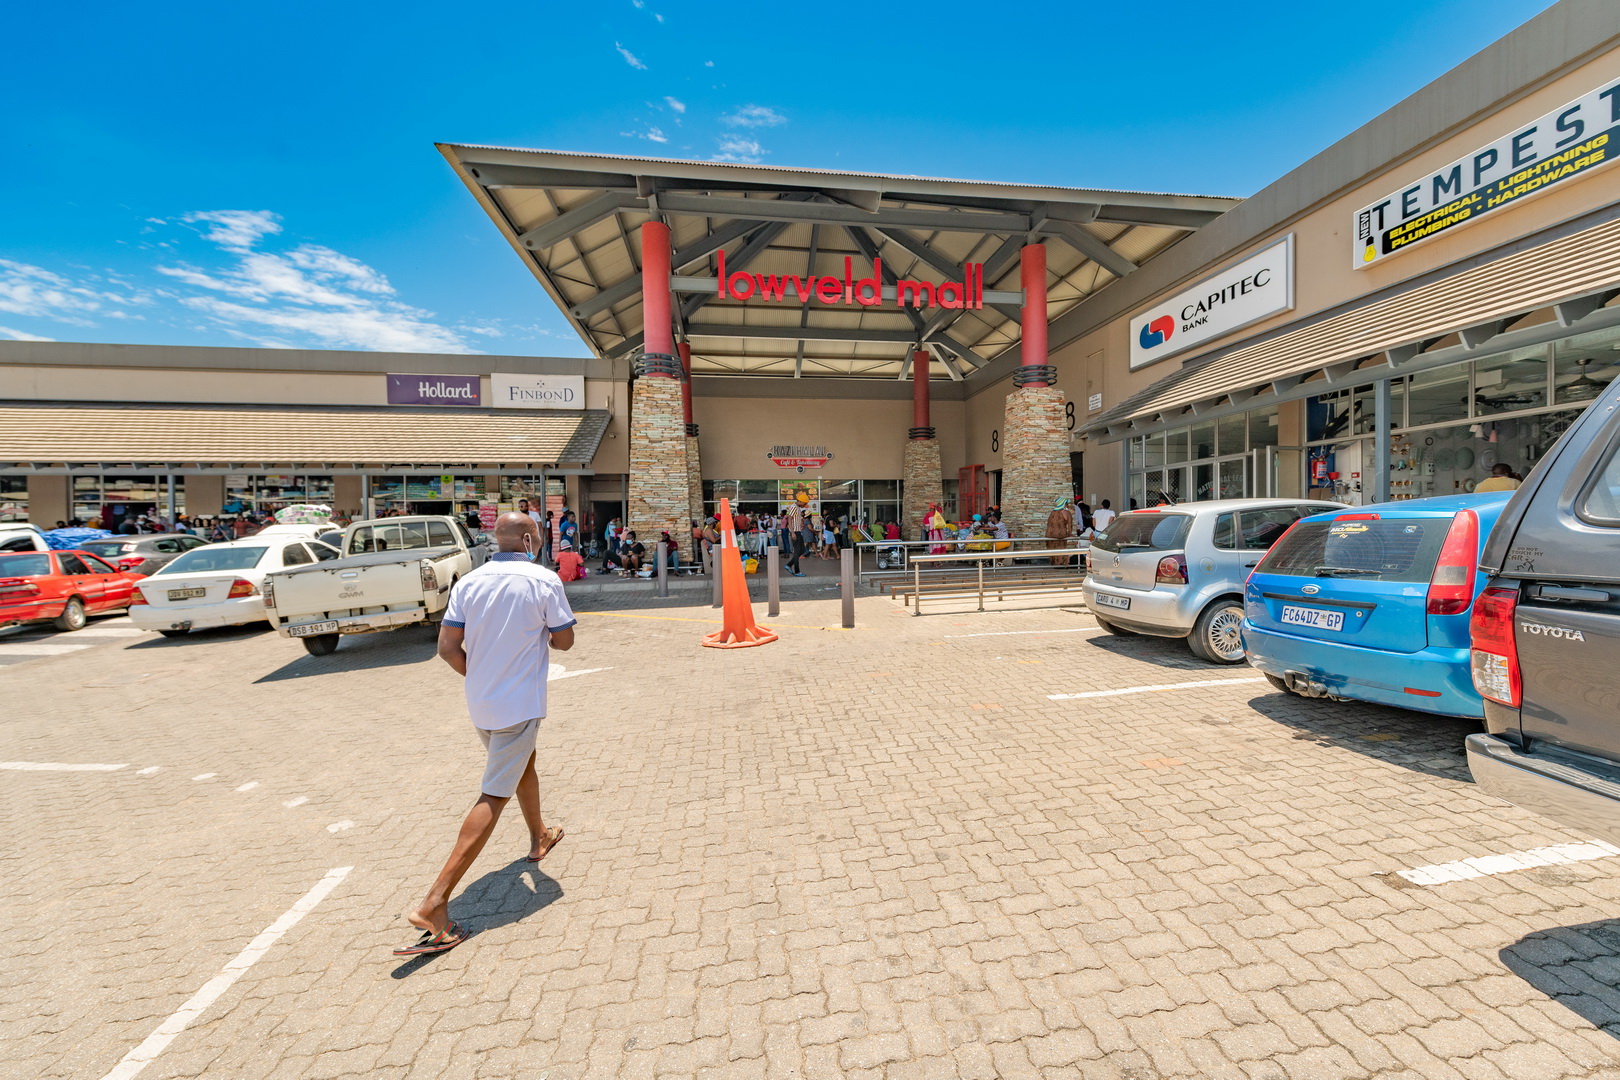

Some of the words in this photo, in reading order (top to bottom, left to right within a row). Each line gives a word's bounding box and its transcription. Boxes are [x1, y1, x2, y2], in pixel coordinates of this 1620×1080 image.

[1372, 83, 1620, 231] TEMPEST
[1389, 193, 1482, 240] ELECTRICAL
[1498, 134, 1609, 192] LIGHTNING
[1391, 208, 1471, 249] PLUMBING
[1487, 149, 1605, 208] HARDWARE
[1360, 212, 1370, 239] NEW
[717, 249, 882, 306] lowveld
[897, 262, 983, 310] mall
[1180, 268, 1271, 321] CAPITEC
[1182, 315, 1209, 333] BANK
[509, 386, 574, 402] FINBOND
[992, 430, 999, 452] 8
[338, 591, 364, 599] GWM
[292, 625, 307, 636] DSB
[326, 622, 336, 631] MP
[1282, 608, 1320, 625] FC64DZ
[1326, 613, 1341, 628] GP
[1520, 622, 1586, 642] TOYOTA
